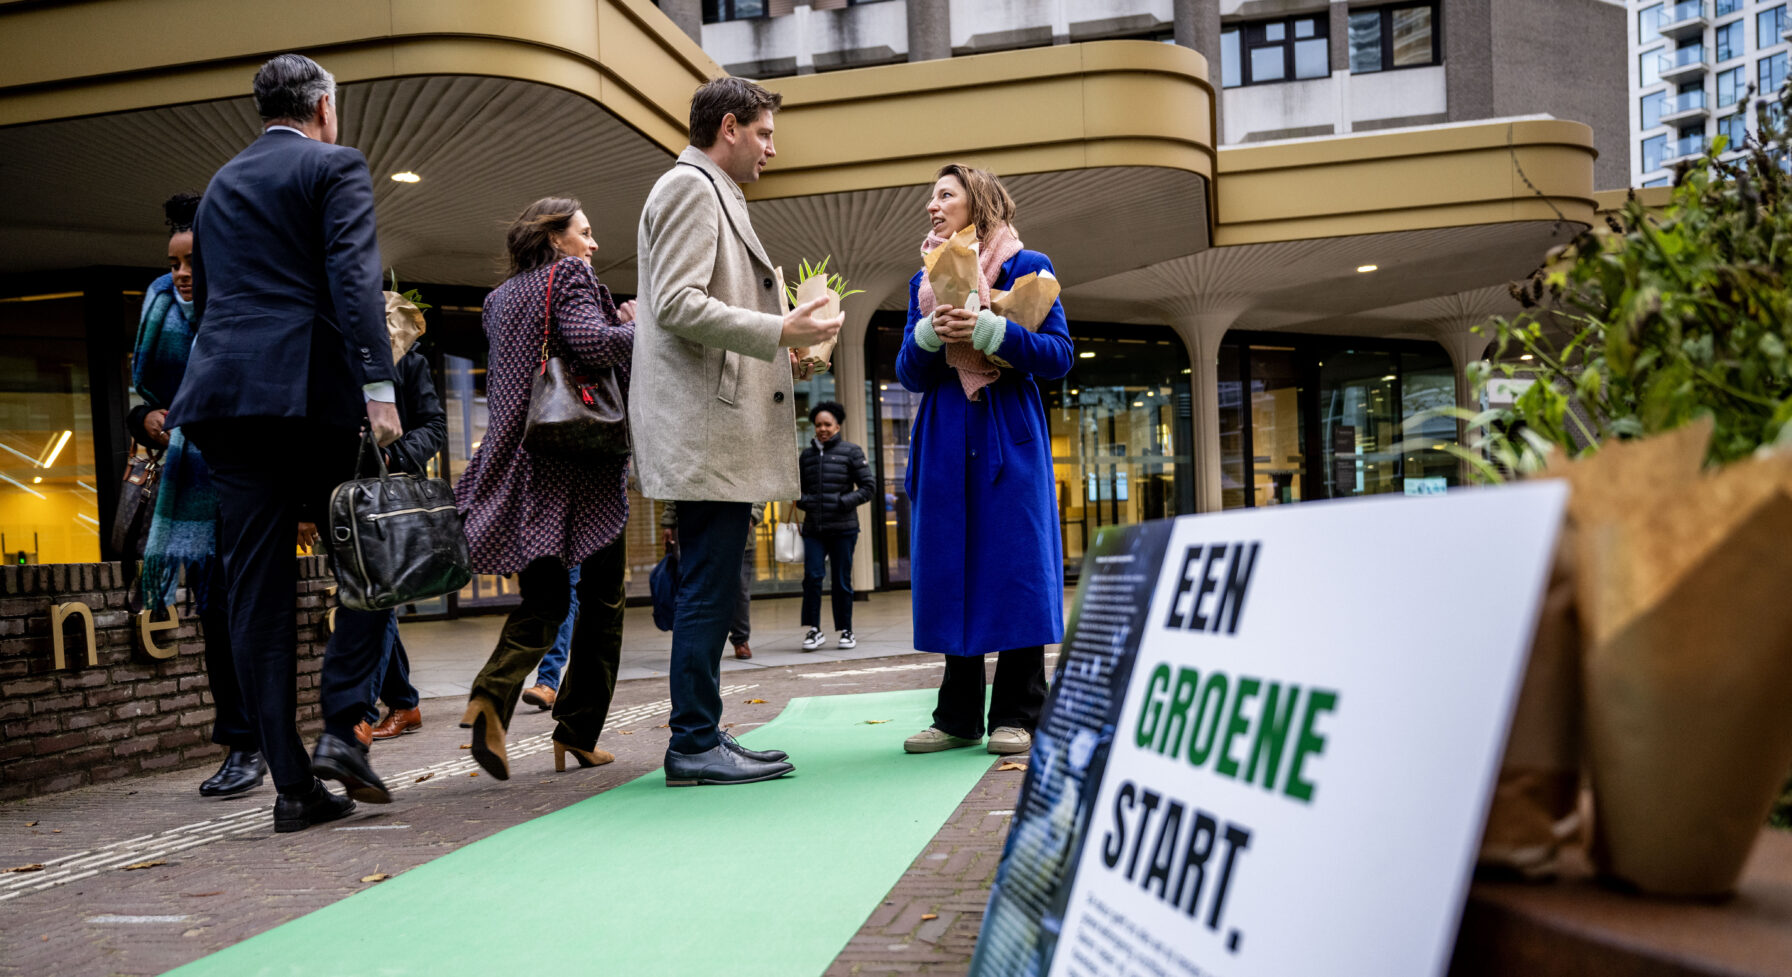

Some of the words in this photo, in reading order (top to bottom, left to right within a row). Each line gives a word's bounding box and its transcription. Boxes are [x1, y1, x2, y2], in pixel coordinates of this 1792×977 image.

[1164, 542, 1261, 636] EEN
[1135, 663, 1340, 805] GROENE
[1102, 781, 1252, 954] START.
